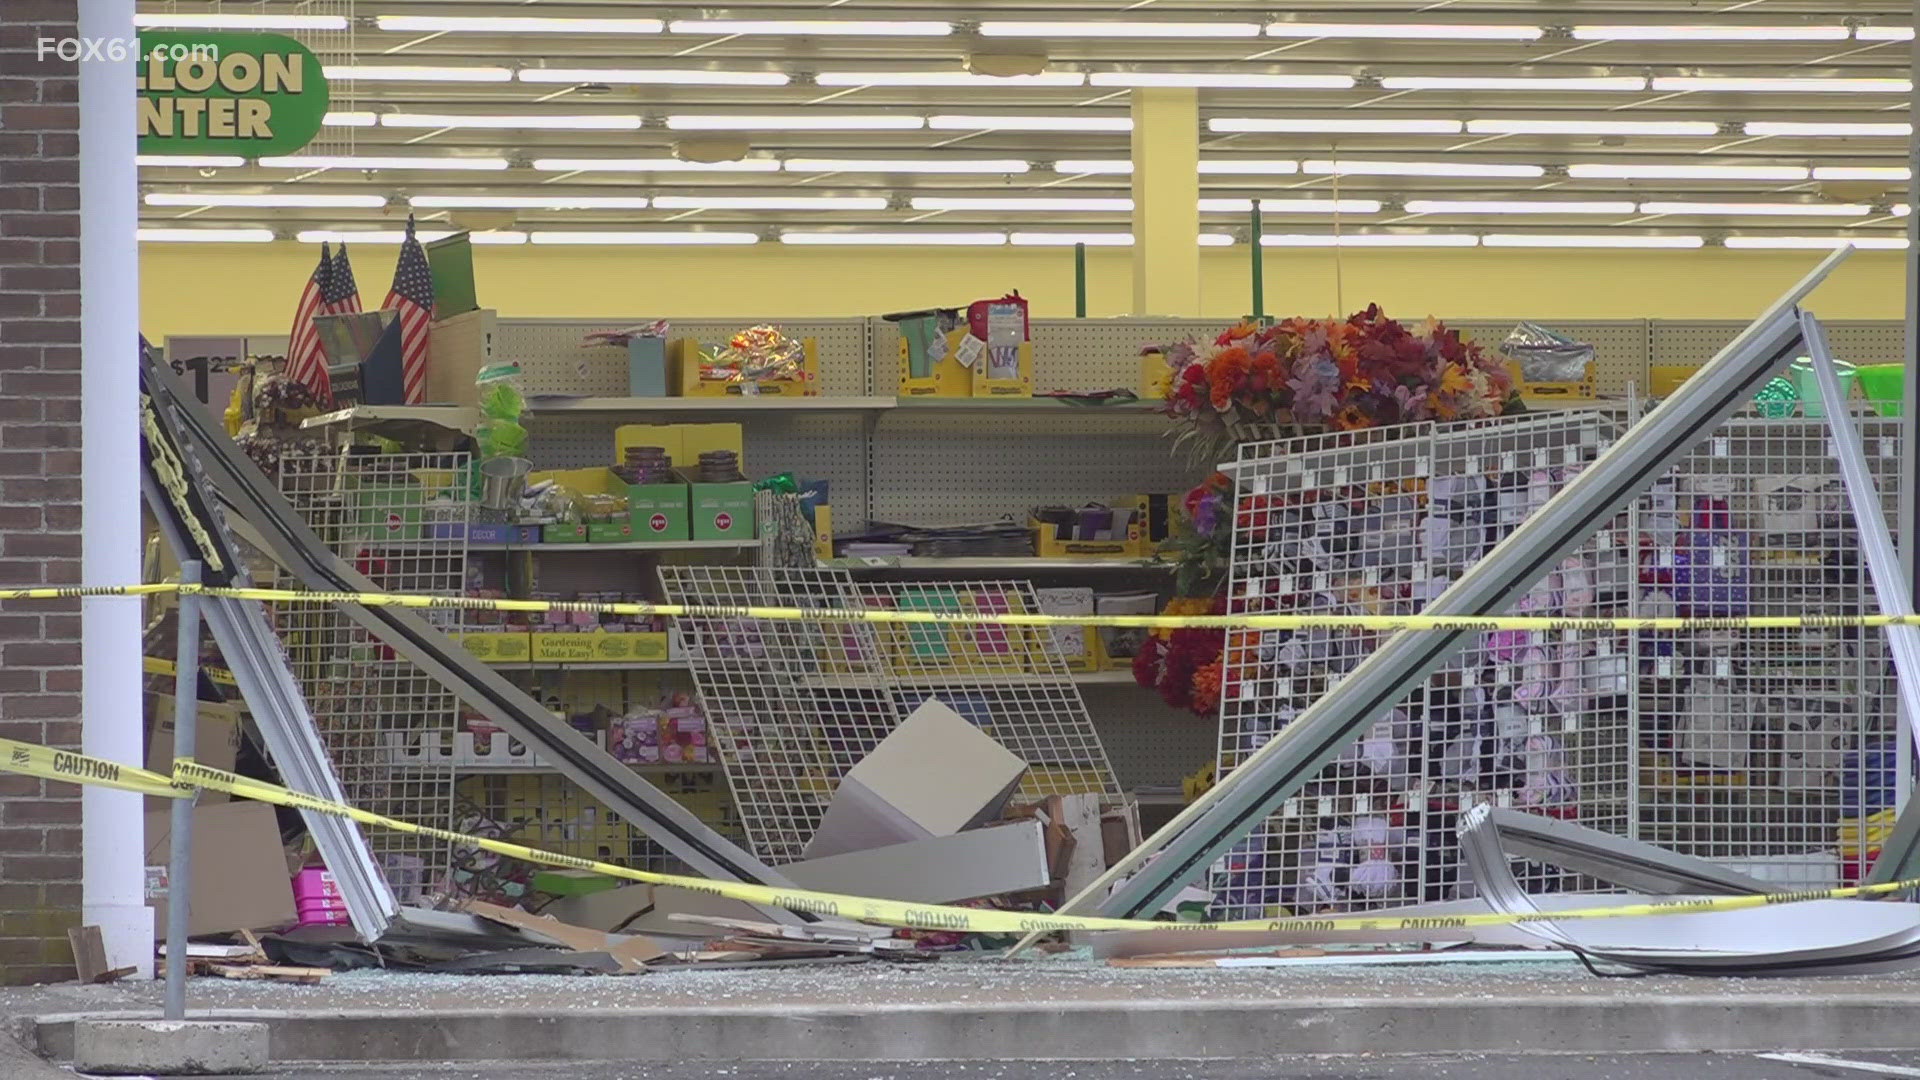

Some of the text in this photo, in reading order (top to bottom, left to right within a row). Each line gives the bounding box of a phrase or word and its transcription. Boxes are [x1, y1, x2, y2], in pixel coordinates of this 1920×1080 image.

[472, 530, 496, 541] DECOR
[541, 637, 593, 651] Gardening
[540, 648, 566, 658] Made
[568, 648, 594, 660] Easy!
[53, 752, 120, 782] CAUTION
[173, 763, 236, 784] CAUTION
[1268, 920, 1335, 932] CUIDADO
[1400, 918, 1467, 930] CAUTION
